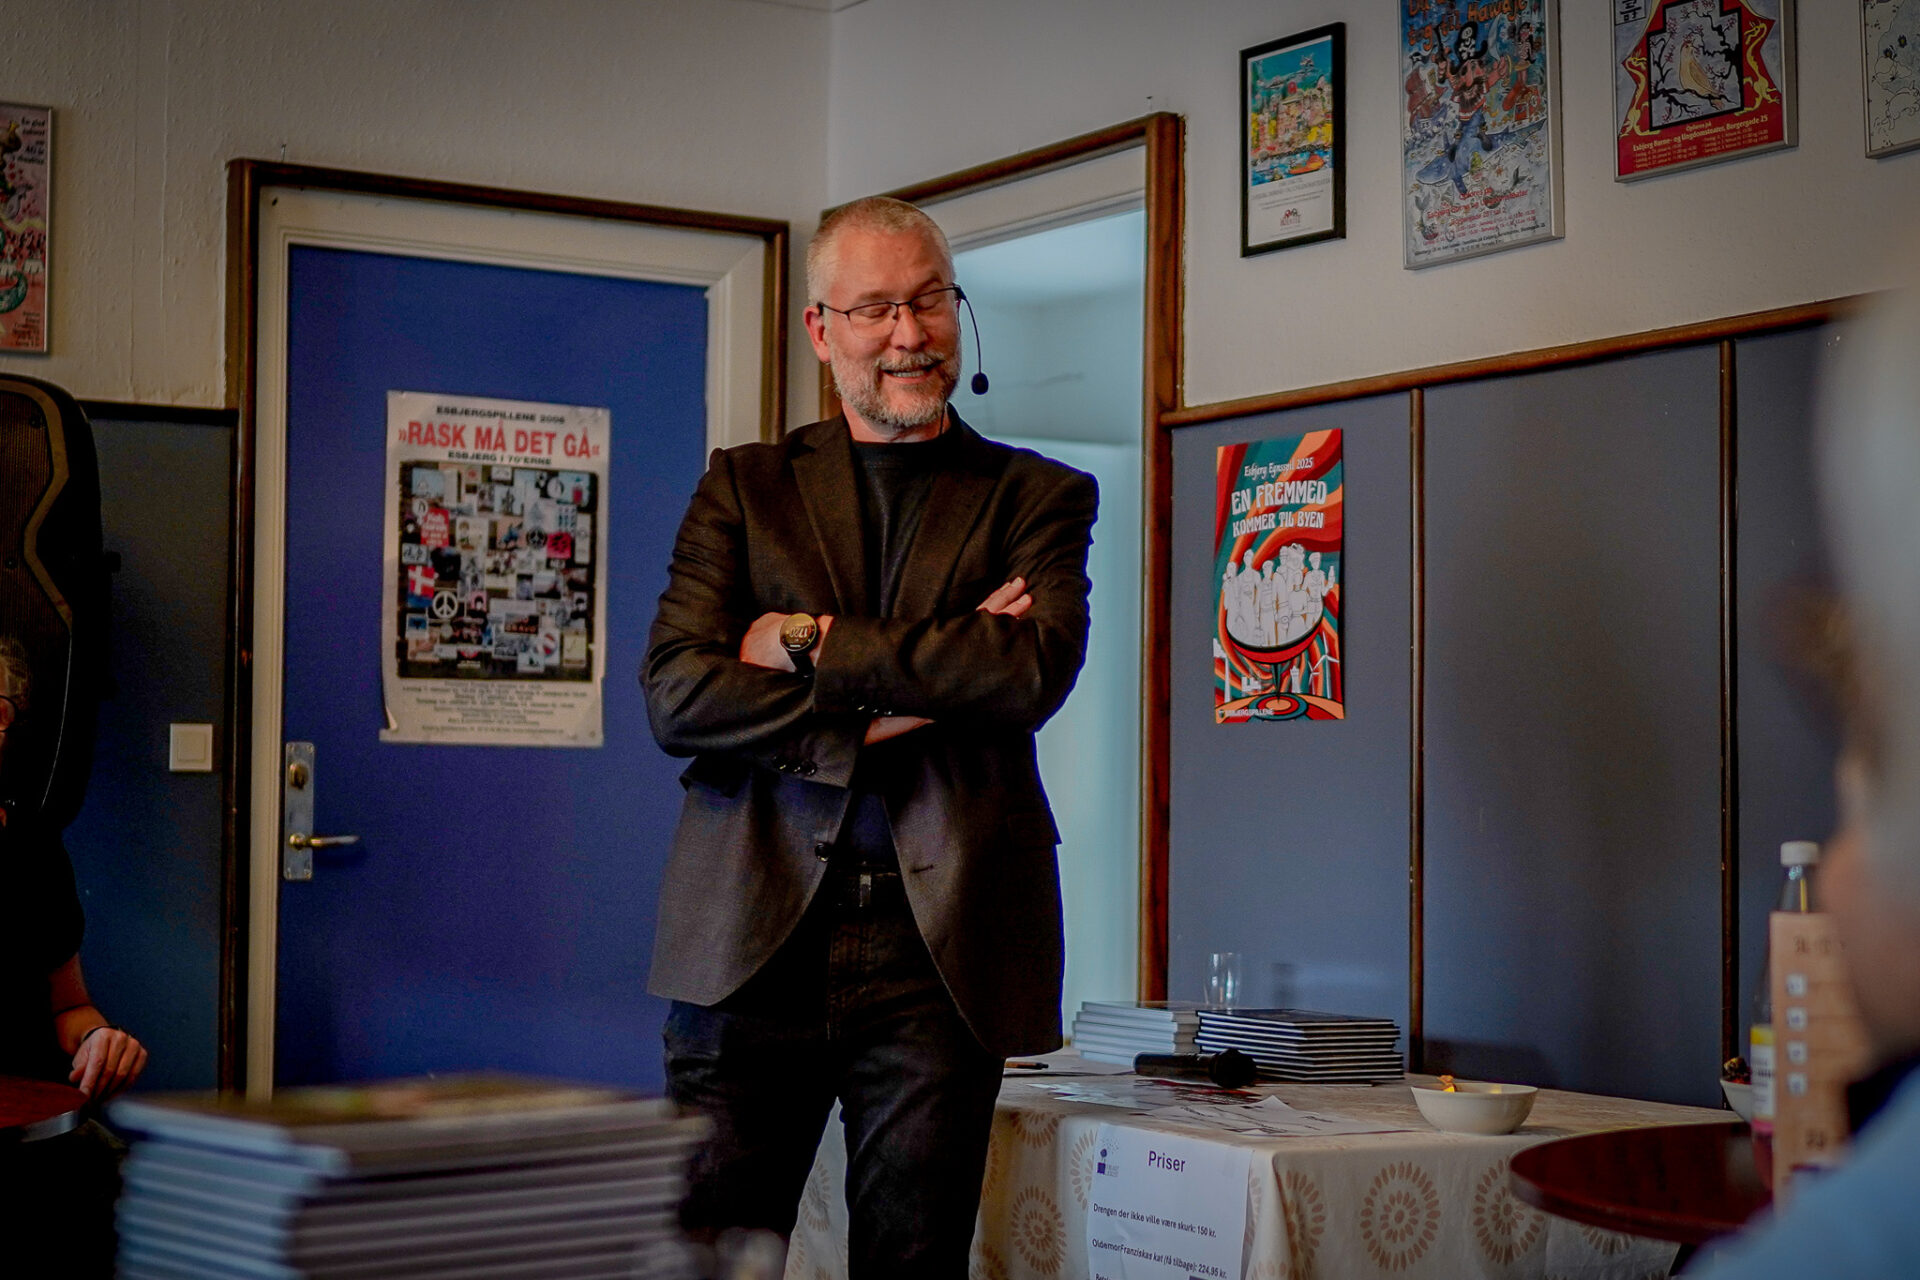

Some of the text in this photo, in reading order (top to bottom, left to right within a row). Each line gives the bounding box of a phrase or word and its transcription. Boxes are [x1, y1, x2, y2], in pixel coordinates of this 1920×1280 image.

[437, 405, 535, 422] ESBJERGSPILLENE
[475, 418, 507, 451] MÅ
[515, 430, 556, 455] DET
[448, 450, 497, 462] ESBJERG
[1244, 462, 1267, 481] Esbjerg
[1296, 456, 1314, 470] 2025
[1231, 479, 1328, 516] EN FREMMED
[1232, 511, 1325, 538] KOMMER TIL BYEN
[1148, 1149, 1186, 1173] Priser
[1093, 1203, 1217, 1238] Drengen der ikke ville være skurk: 150 kr.
[1153, 1252, 1164, 1264] kat
[1198, 1263, 1219, 1277] 224,95
[1219, 1268, 1228, 1279] kr.
